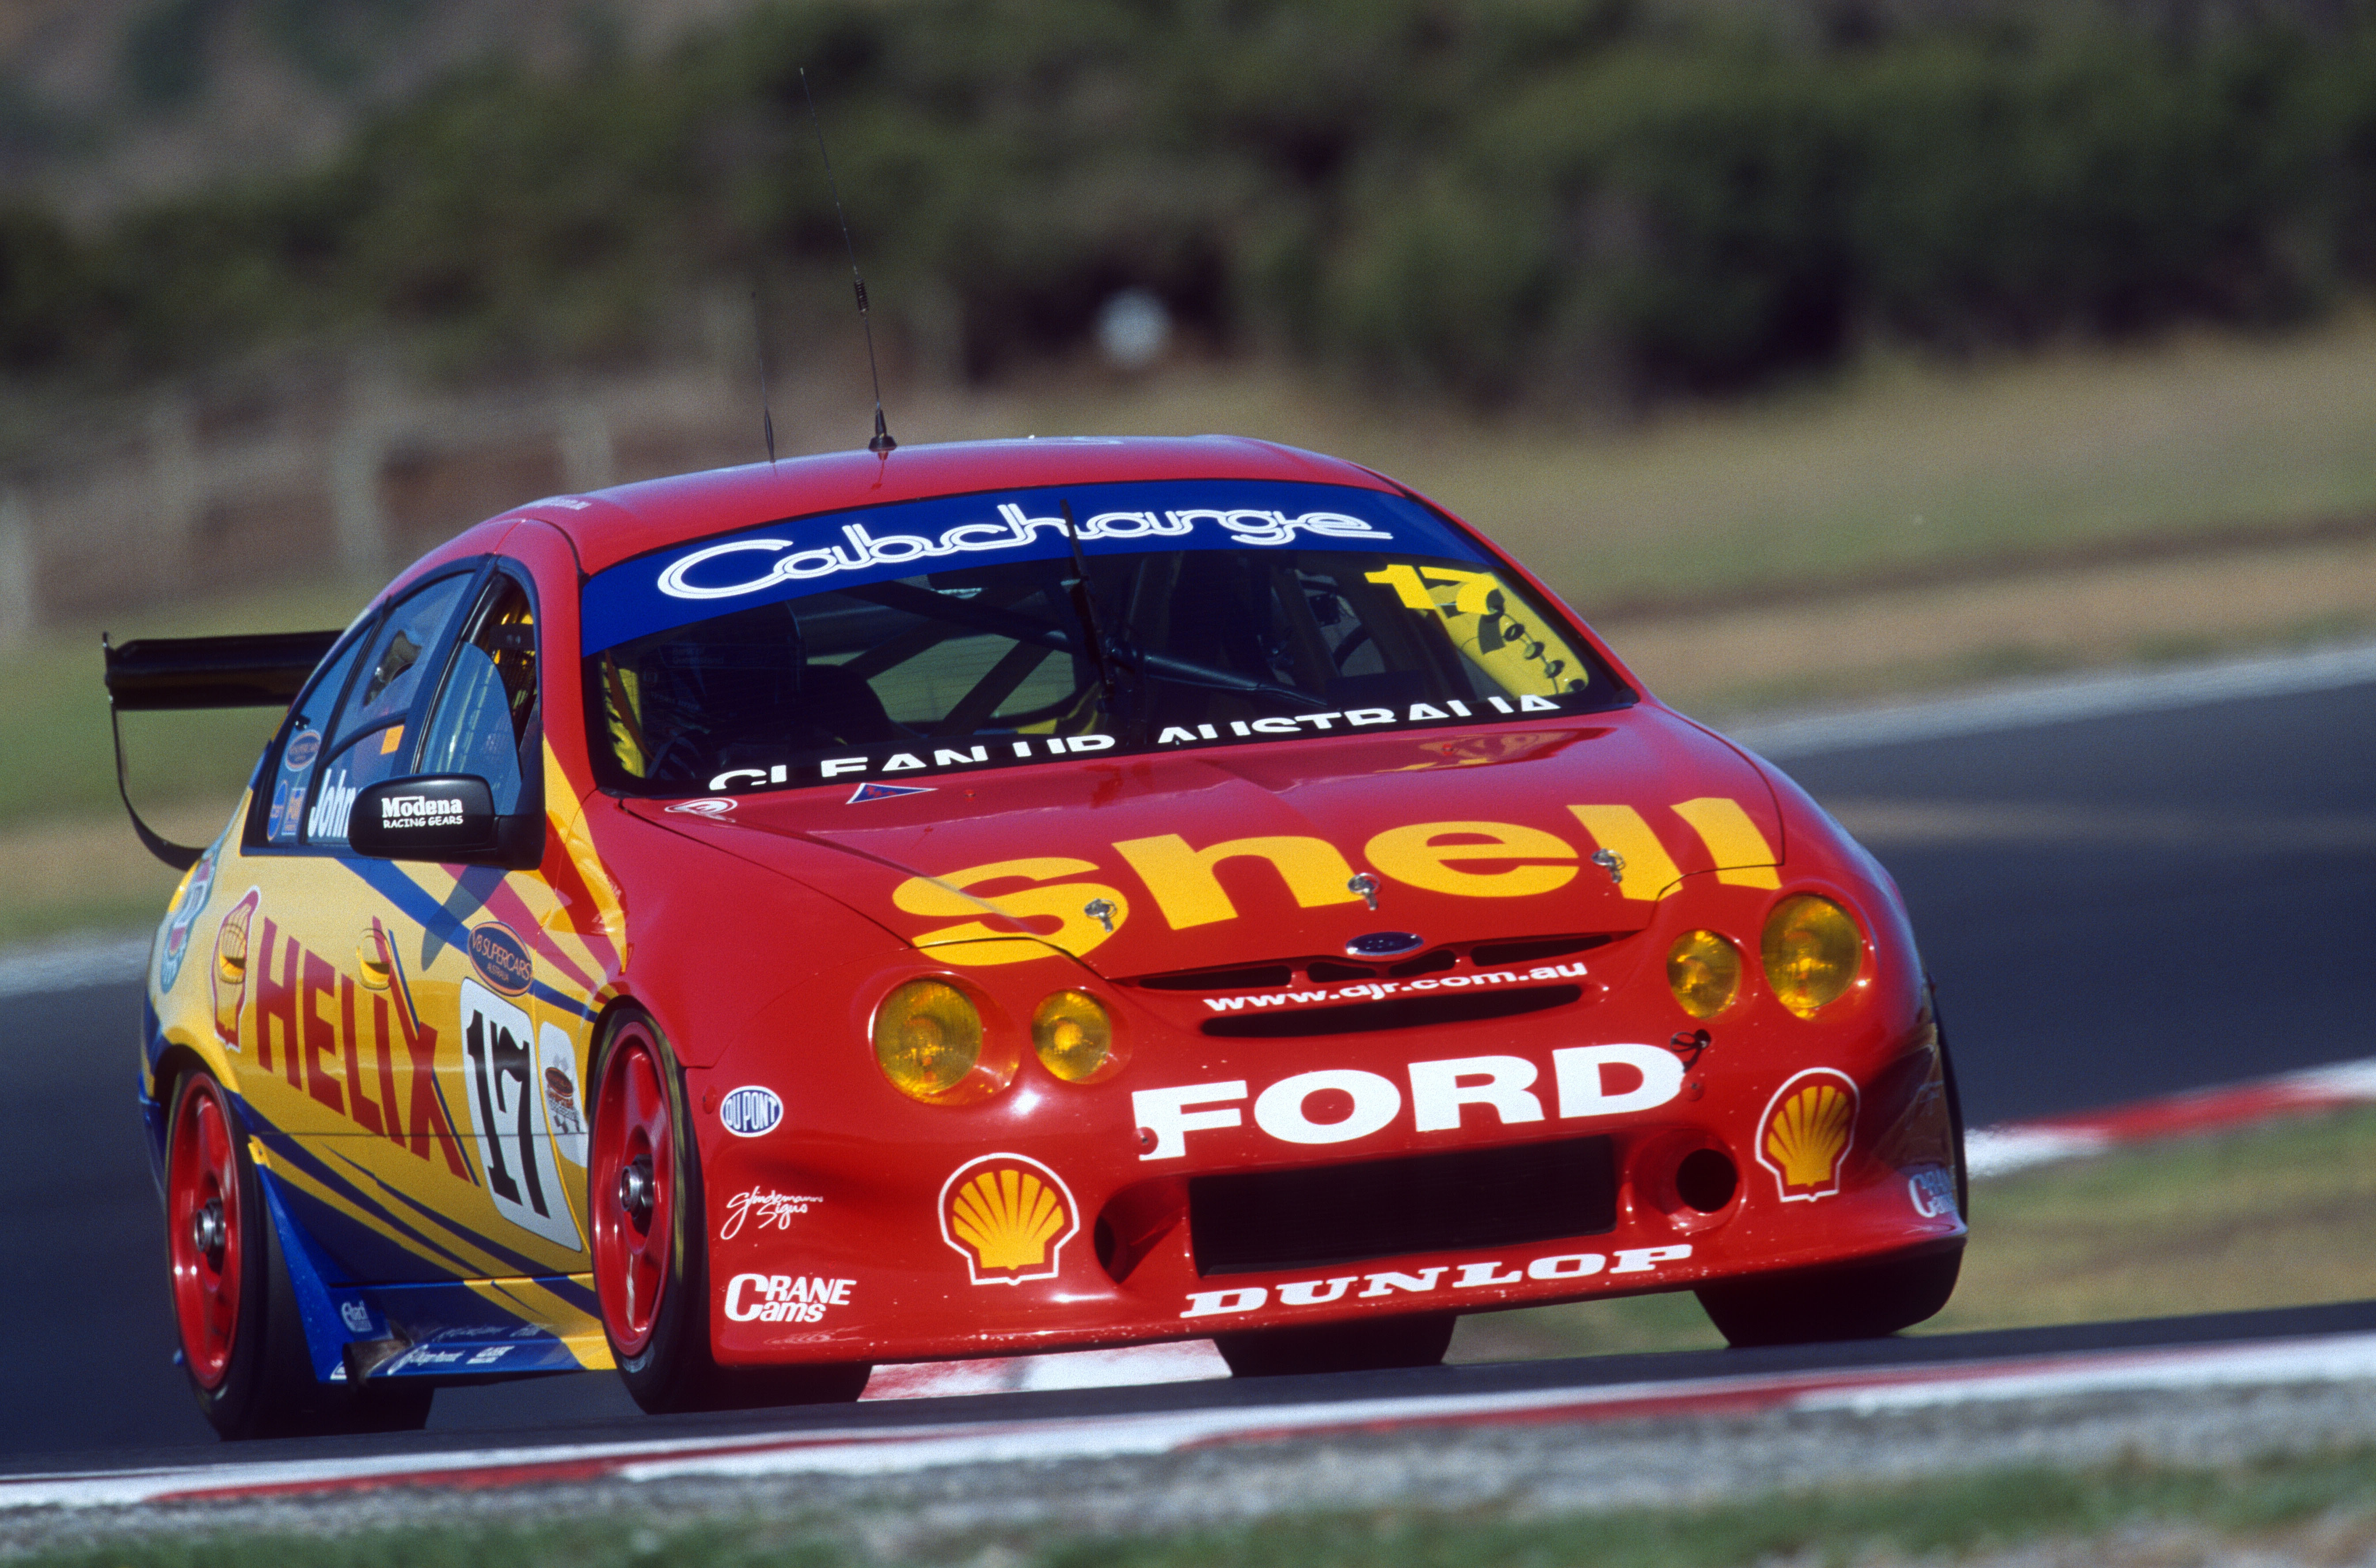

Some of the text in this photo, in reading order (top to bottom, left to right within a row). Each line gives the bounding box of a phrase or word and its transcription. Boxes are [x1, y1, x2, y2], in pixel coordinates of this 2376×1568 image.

[657, 502, 1394, 600] Cabcharge
[1364, 564, 1499, 615] 17
[308, 768, 362, 838] John
[381, 796, 464, 818] Modena
[383, 815, 464, 829] RACING GEARS
[472, 931, 532, 981] V8 SUPERCARS
[1202, 961, 1589, 1012] www.djr.com.au
[256, 915, 472, 1183] HELIX
[466, 1009, 551, 1219] 17
[1131, 1043, 1685, 1161] FORD
[1179, 1244, 1693, 1319] DUNLOP
